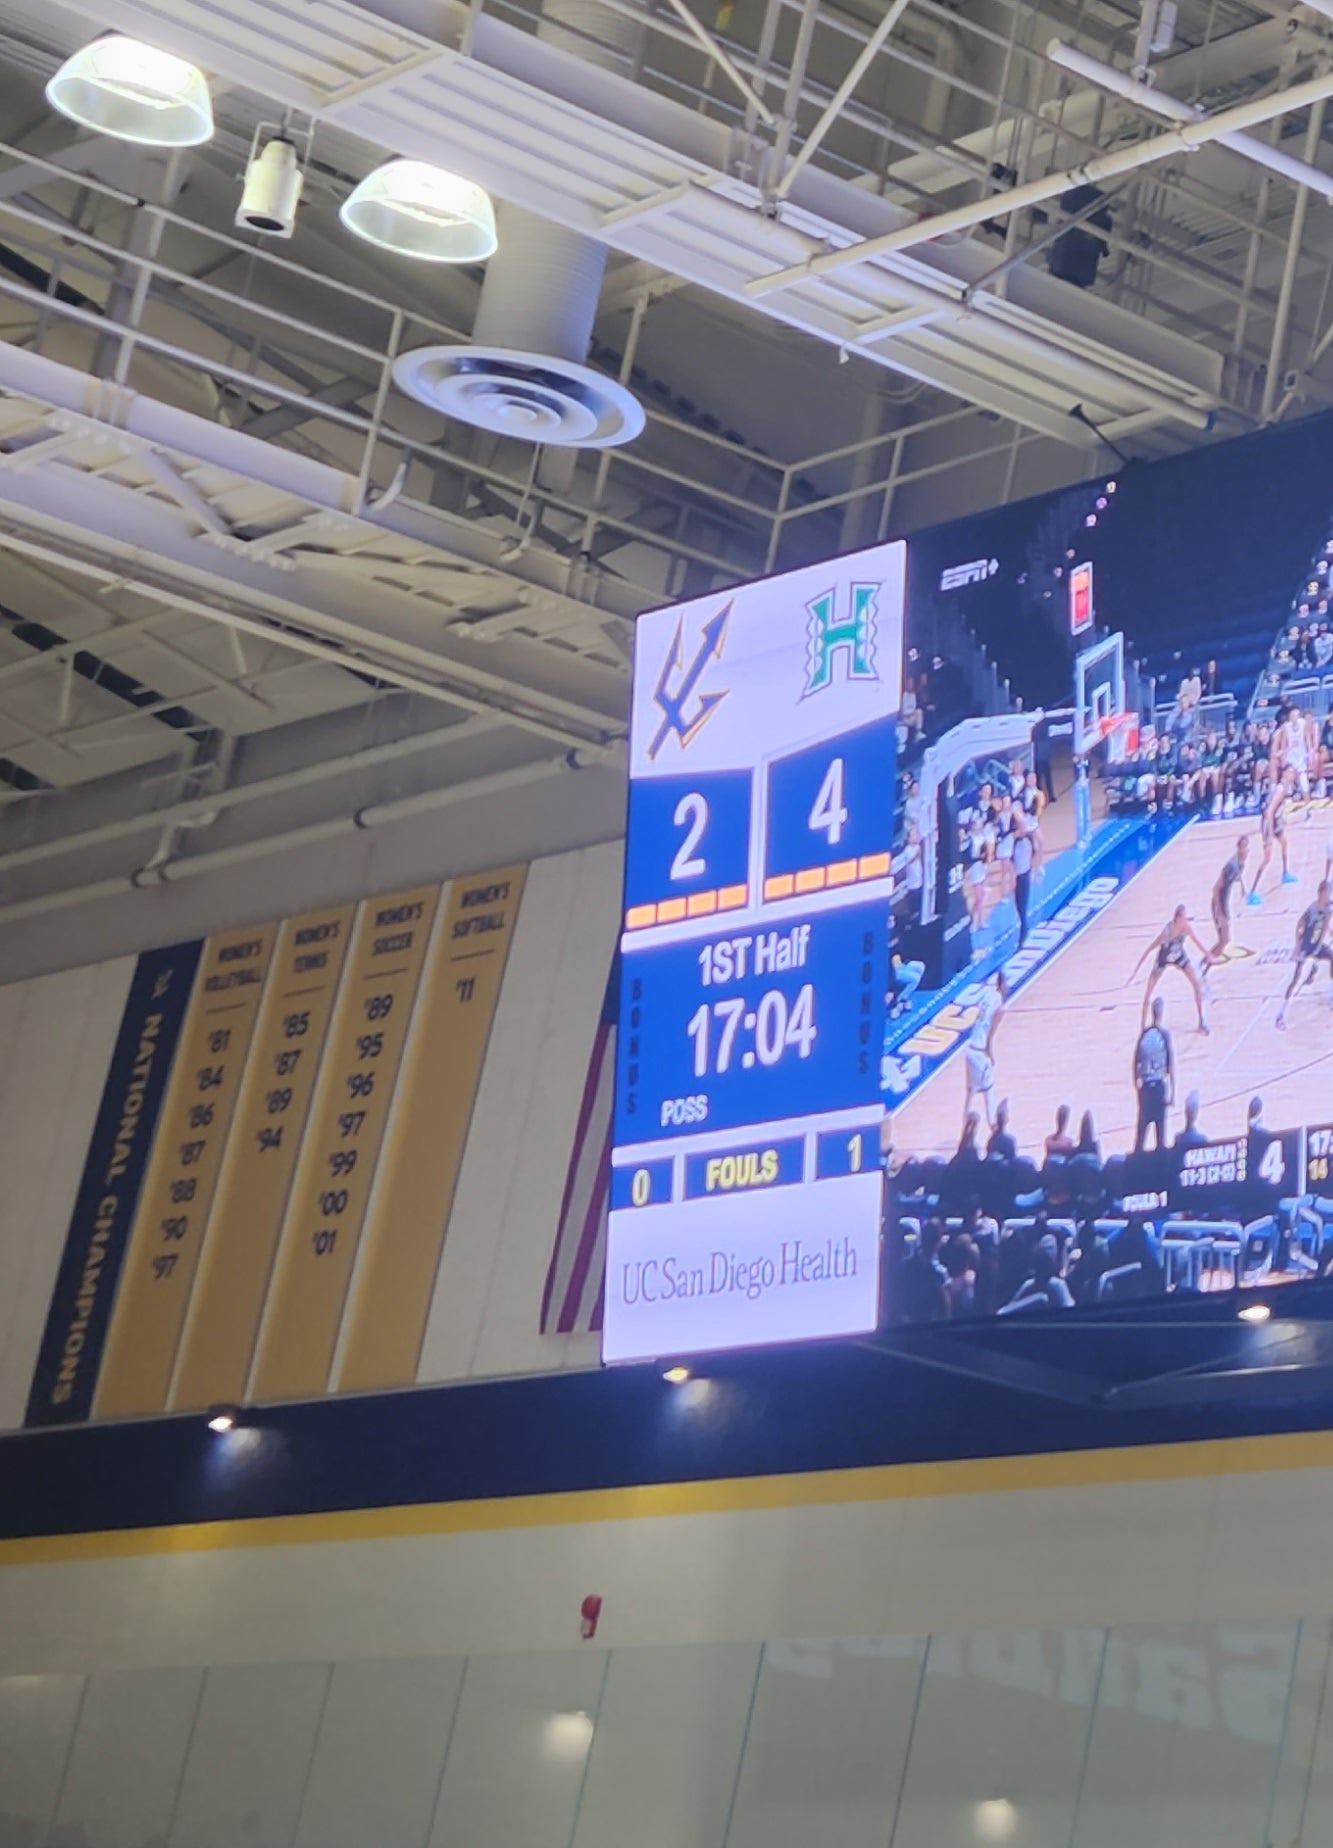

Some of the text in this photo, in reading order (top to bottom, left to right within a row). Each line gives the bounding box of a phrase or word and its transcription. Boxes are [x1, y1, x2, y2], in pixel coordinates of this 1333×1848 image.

[670, 792, 710, 880] 2
[808, 758, 848, 845] 4
[699, 925, 811, 986] 1ST Half
[688, 984, 817, 1076] 17:04
[661, 1094, 708, 1127] POSS
[632, 1134, 862, 1206] 0 FOULS 1
[1258, 1140, 1286, 1185] 4
[52, 1012, 164, 1404] NATIONAL CHAMPIONS
[622, 1237, 858, 1304] UC San Diego Health
